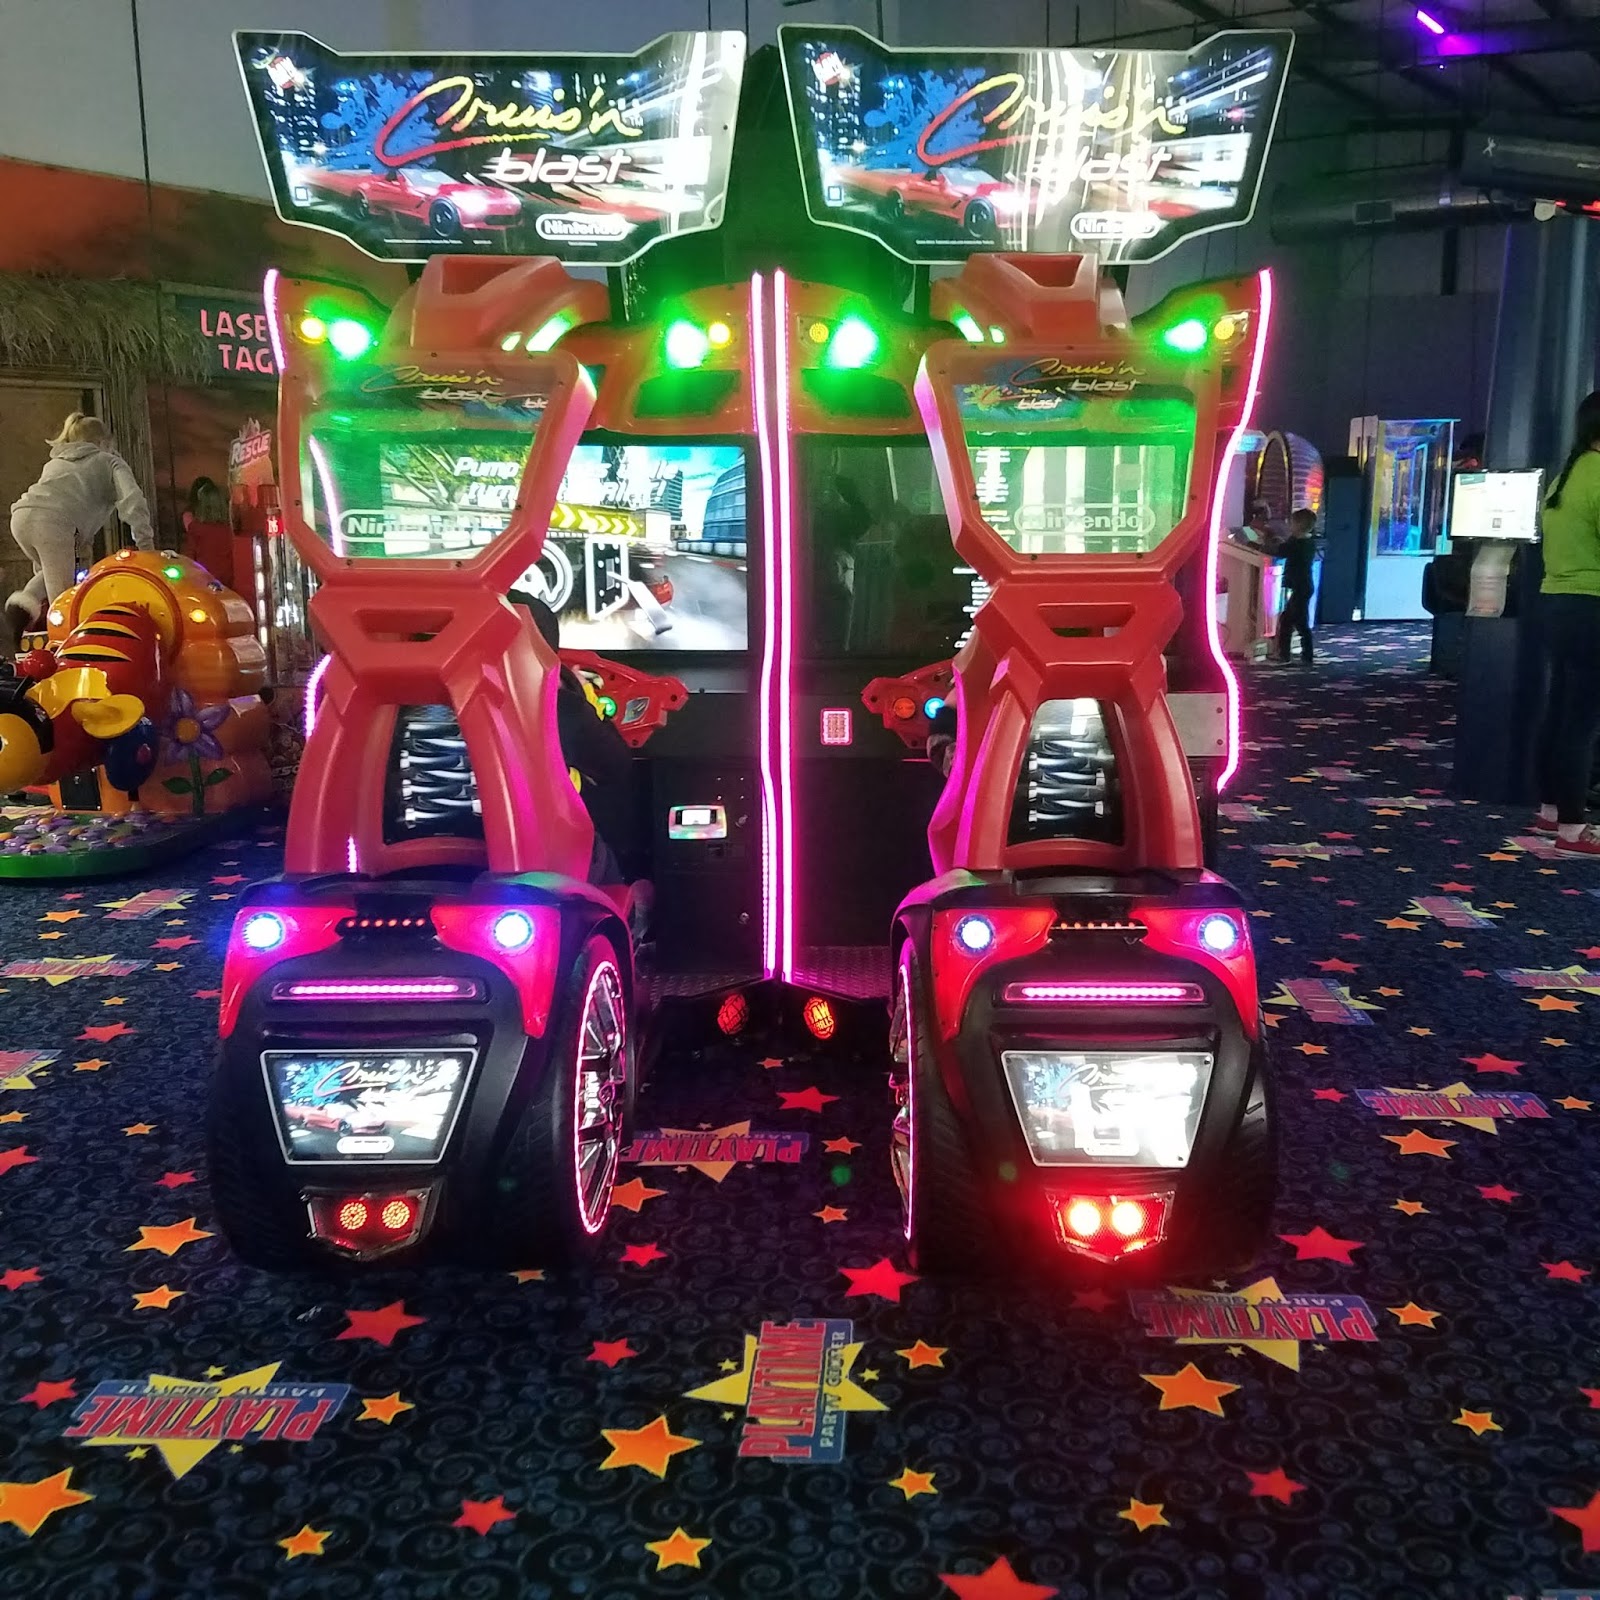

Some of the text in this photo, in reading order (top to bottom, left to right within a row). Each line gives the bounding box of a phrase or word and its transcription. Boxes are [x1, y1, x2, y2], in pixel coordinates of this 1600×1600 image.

[374, 75, 643, 167] Cruis'n
[486, 147, 632, 183] blast
[1026, 145, 1173, 183] last
[542, 217, 623, 236] Nintendo
[1078, 216, 1152, 235] Nino
[200, 309, 268, 342] LASE
[218, 344, 274, 375] TAG
[1009, 358, 1146, 386] Cruis'n
[360, 365, 501, 392] Cruis'n
[1069, 378, 1138, 392] blast
[419, 387, 490, 401] blast
[1016, 396, 1063, 410] blast
[231, 432, 271, 466] RESCUE
[453, 456, 520, 479] Pump
[1024, 511, 1142, 529] inendo
[1365, 1096, 1554, 1119] PLAYTIME
[1139, 1302, 1379, 1342] PLAYTIME
[737, 1320, 827, 1458] PLAYTIME
[61, 1396, 336, 1442] PLAYTIME
[819, 1393, 842, 1448] PARTY
